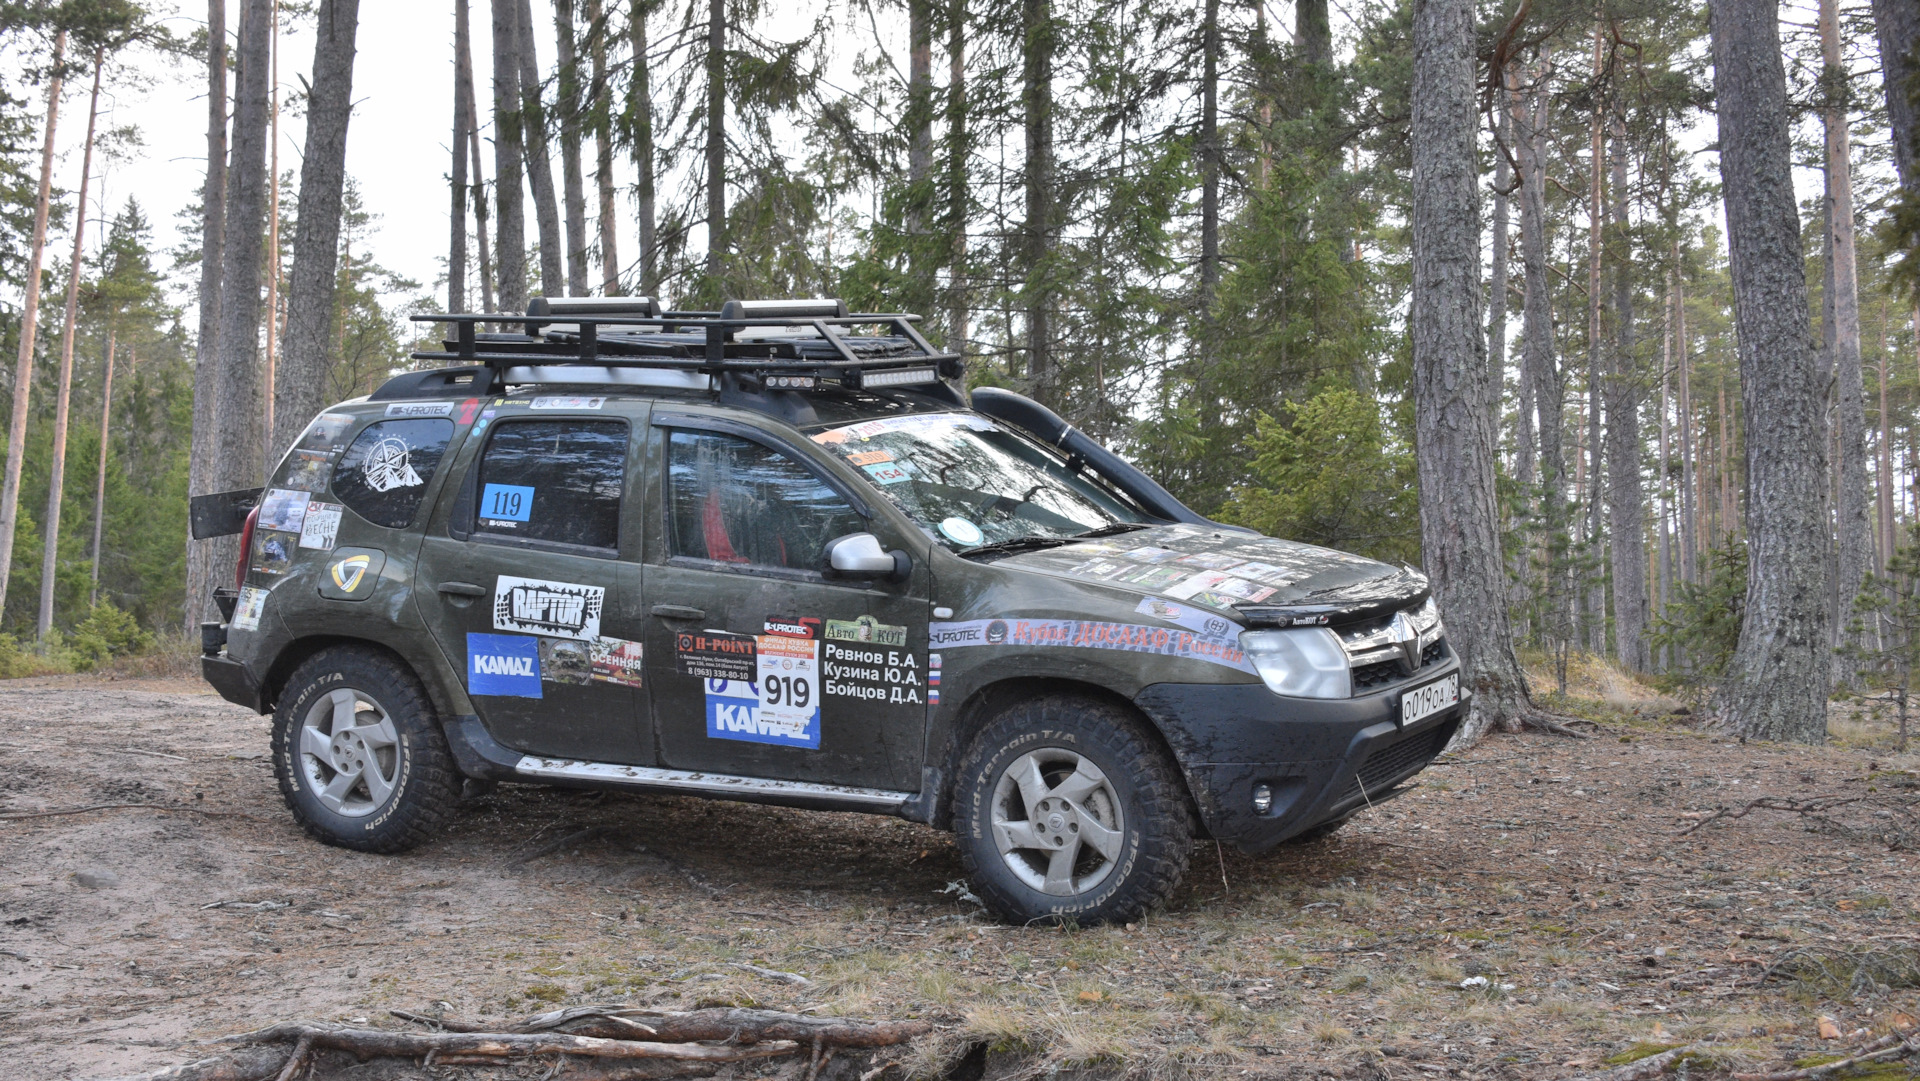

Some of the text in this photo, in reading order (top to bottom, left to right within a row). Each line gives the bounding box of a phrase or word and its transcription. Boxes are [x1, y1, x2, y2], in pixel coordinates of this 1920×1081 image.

[396, 405, 447, 417] SUPROTEC
[458, 398, 480, 424] 2
[858, 421, 885, 436] 2019
[874, 468, 905, 481] 154
[491, 491, 522, 517] 119
[513, 587, 585, 626] RAPTOR
[767, 622, 807, 635] SUPROTEC
[878, 629, 904, 644] КОТ
[929, 628, 981, 643] SUPROTEC
[1014, 621, 1244, 664] Кубок ДОСААФ России
[474, 654, 535, 677] KAMAZ
[590, 650, 642, 671] ОСЕННЯЯ
[825, 644, 920, 669] Ревнов Б.А.
[318, 671, 344, 685] T/A
[688, 666, 749, 680] 8 (963) 338-80-10
[824, 661, 880, 681] Кузина
[884, 667, 922, 687] Ю.А.
[765, 674, 810, 708] 919
[825, 679, 923, 705] Бойцов Д.А.
[364, 733, 411, 831] BFGoodrich
[973, 729, 1077, 840] Mud-Terrain T/A
[1051, 830, 1140, 915] BFGoodrich
